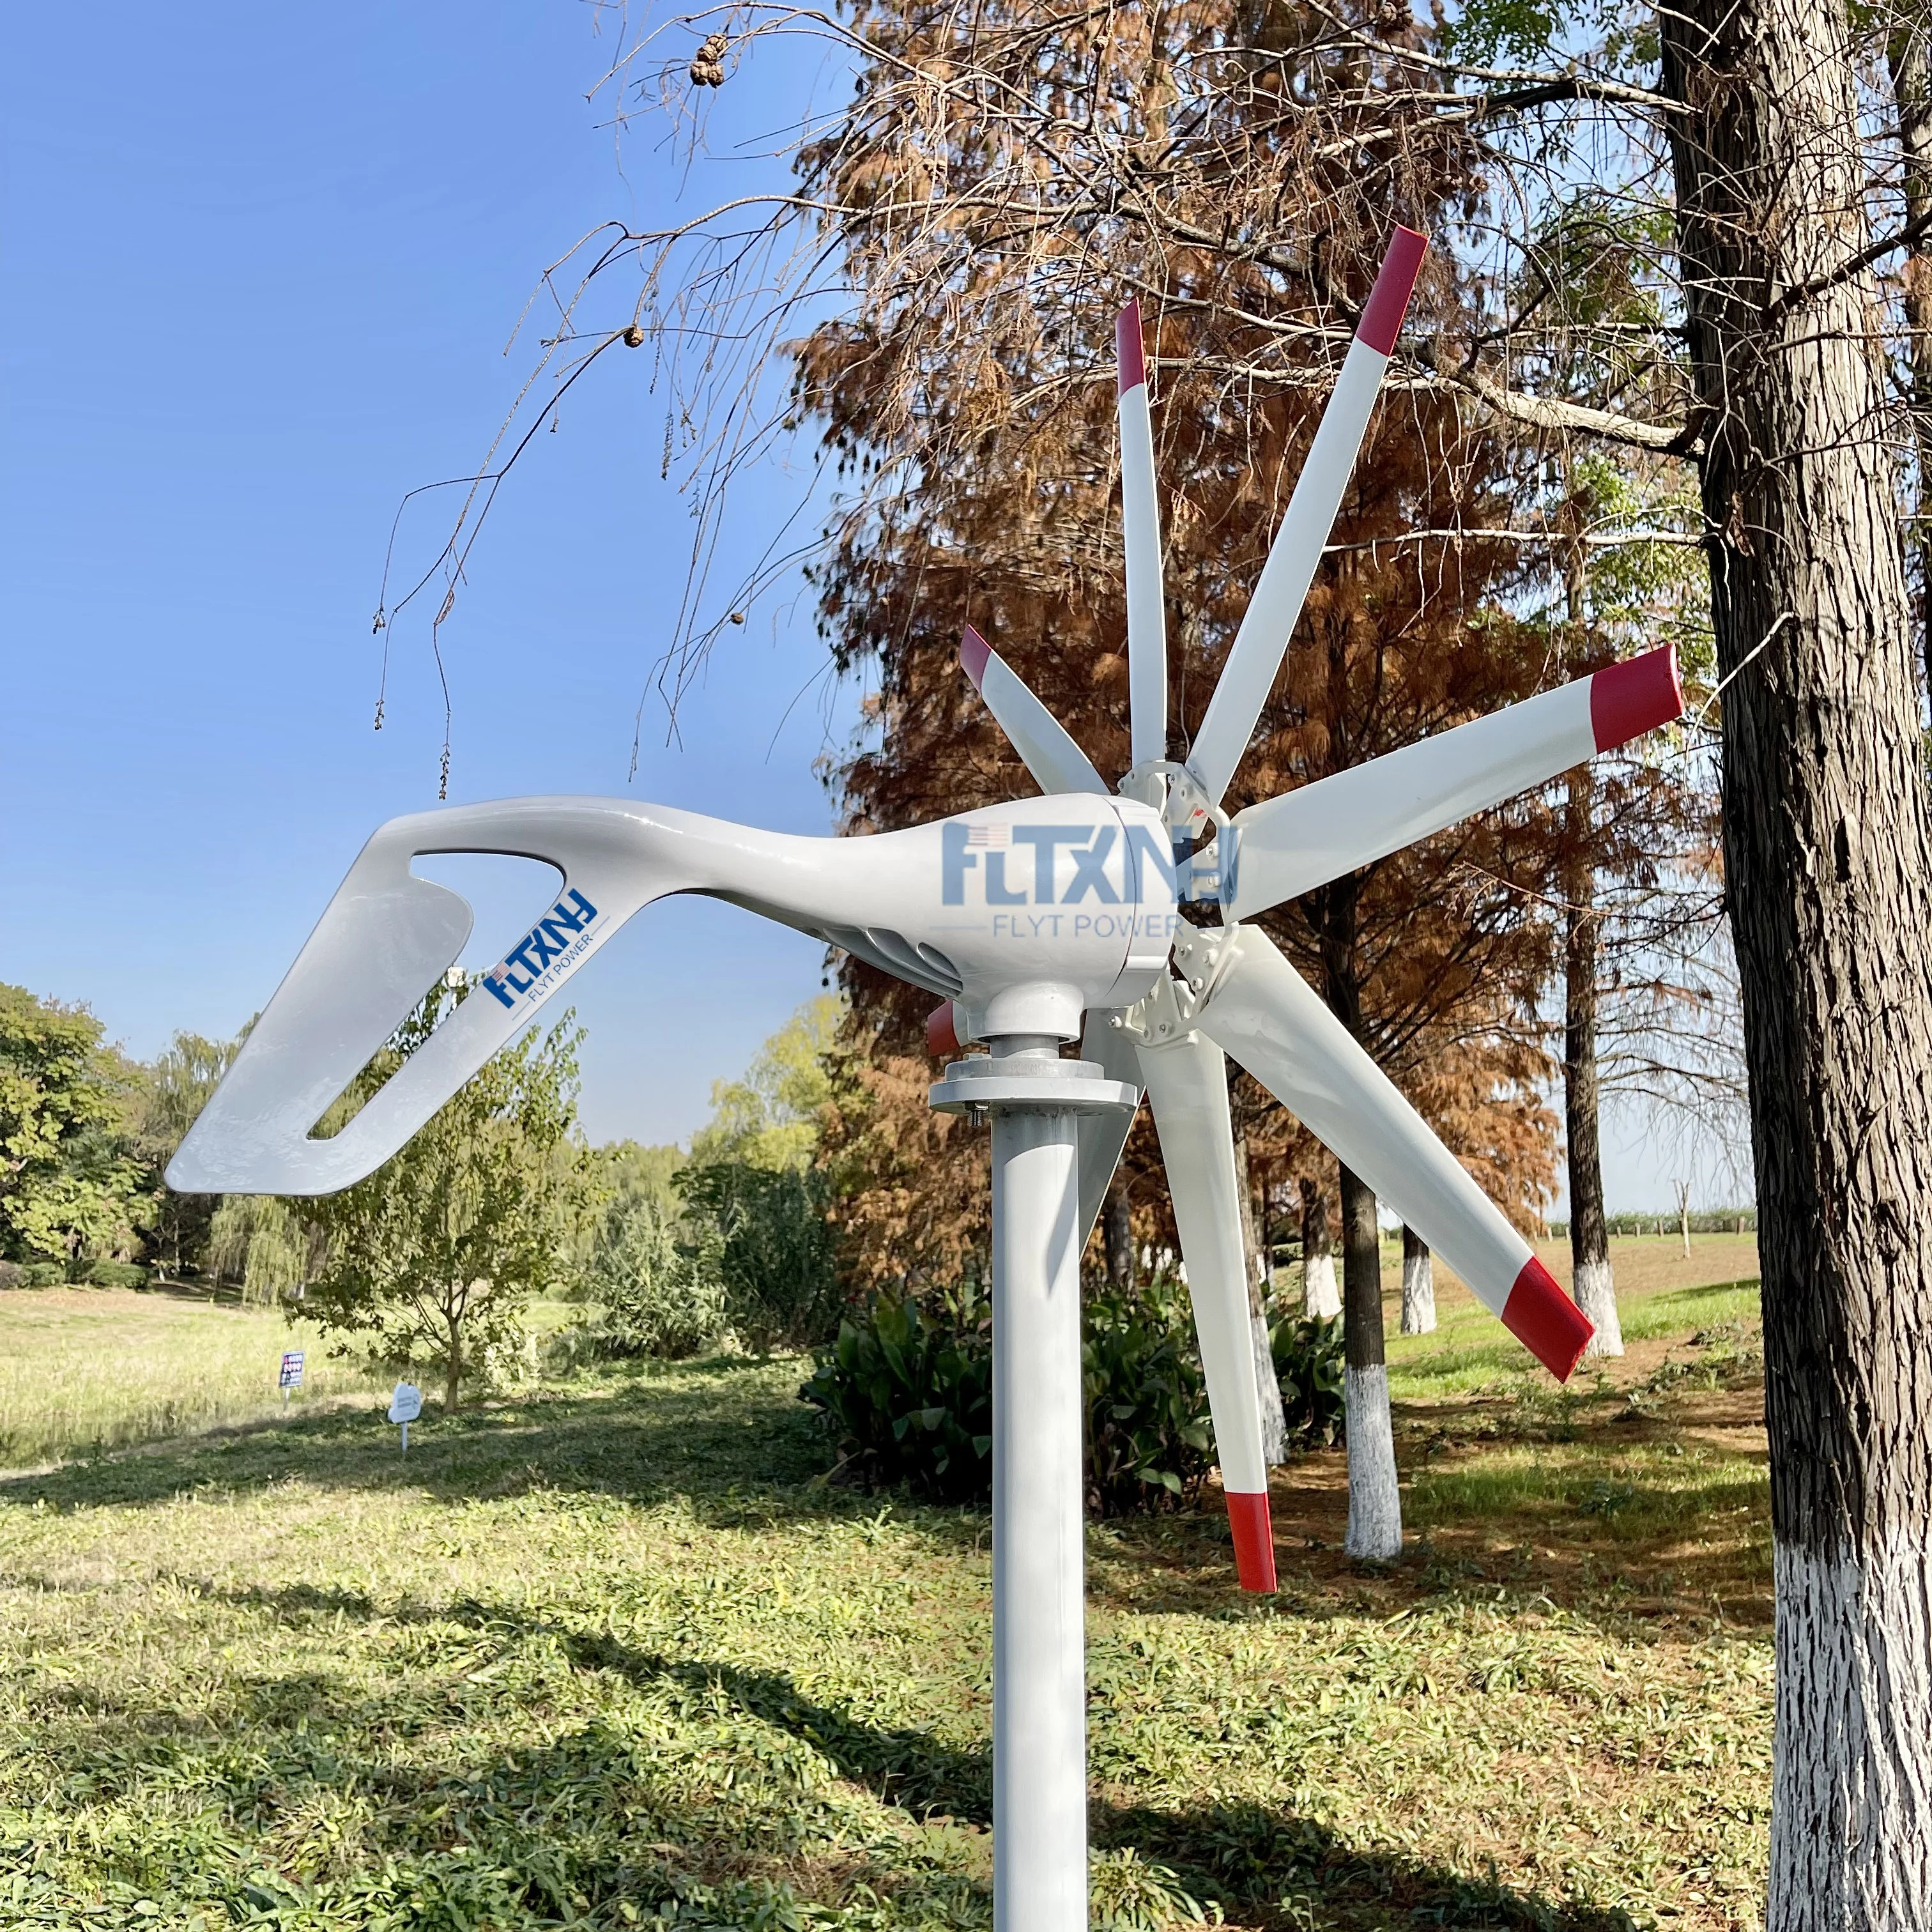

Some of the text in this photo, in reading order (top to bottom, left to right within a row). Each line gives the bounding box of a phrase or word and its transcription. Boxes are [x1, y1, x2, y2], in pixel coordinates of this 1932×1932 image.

[482, 888, 598, 1009] FLTXNY
[528, 933, 593, 1002] FLYT POWER
